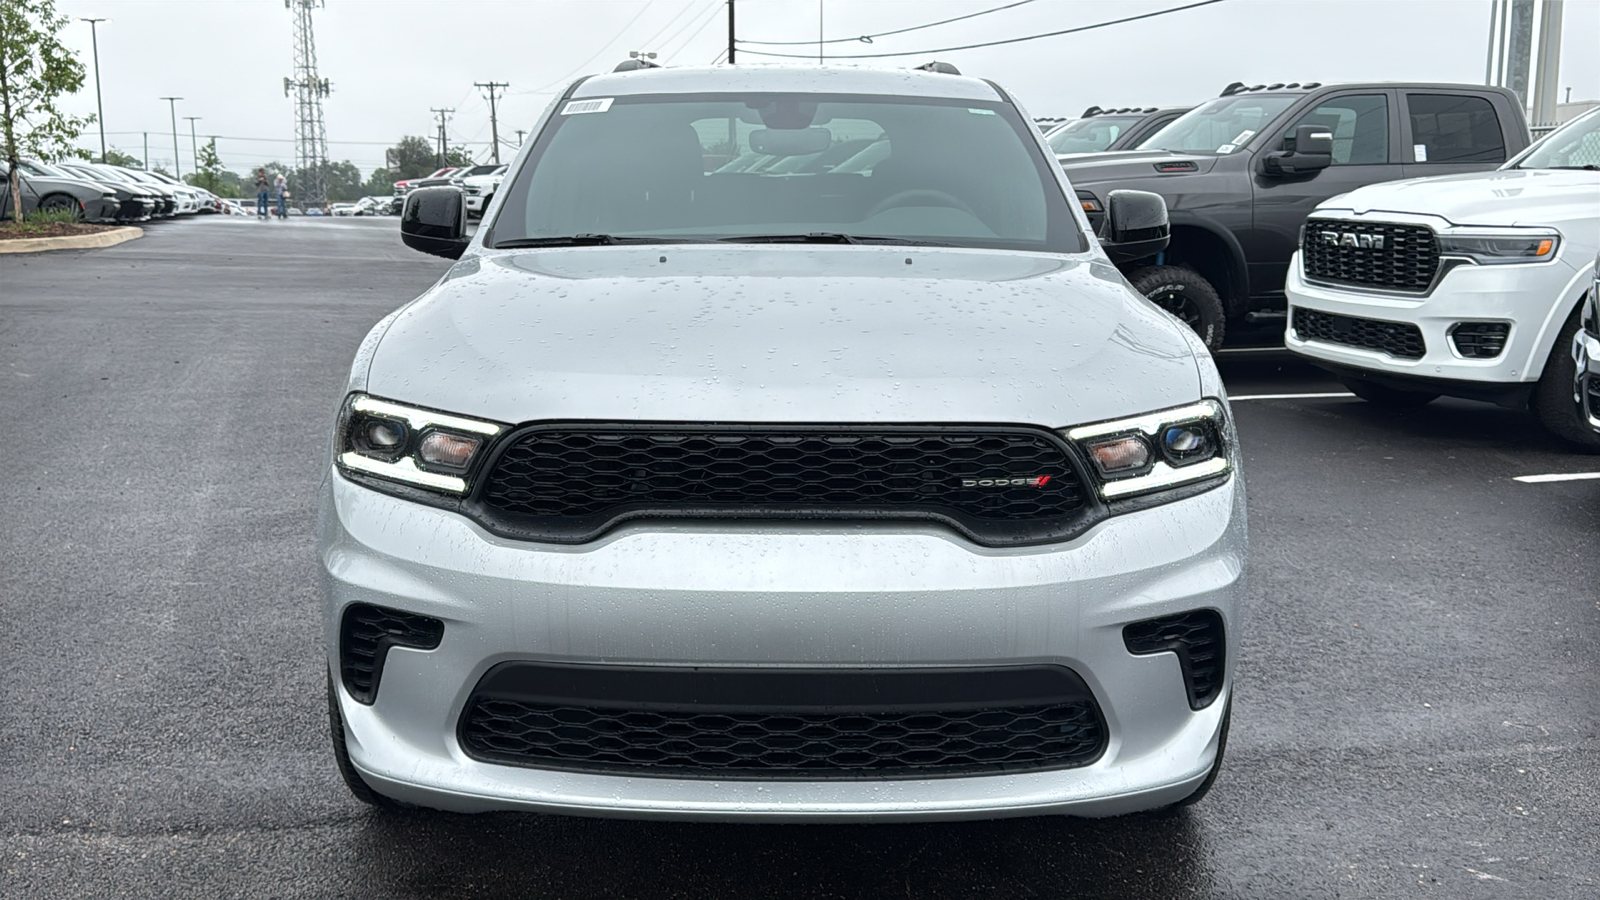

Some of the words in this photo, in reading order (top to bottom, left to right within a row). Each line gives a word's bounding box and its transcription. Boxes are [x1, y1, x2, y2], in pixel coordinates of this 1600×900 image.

[1321, 231, 1384, 249] RAM
[1146, 284, 1185, 298] YEAR
[962, 478, 1041, 487] DODGE
